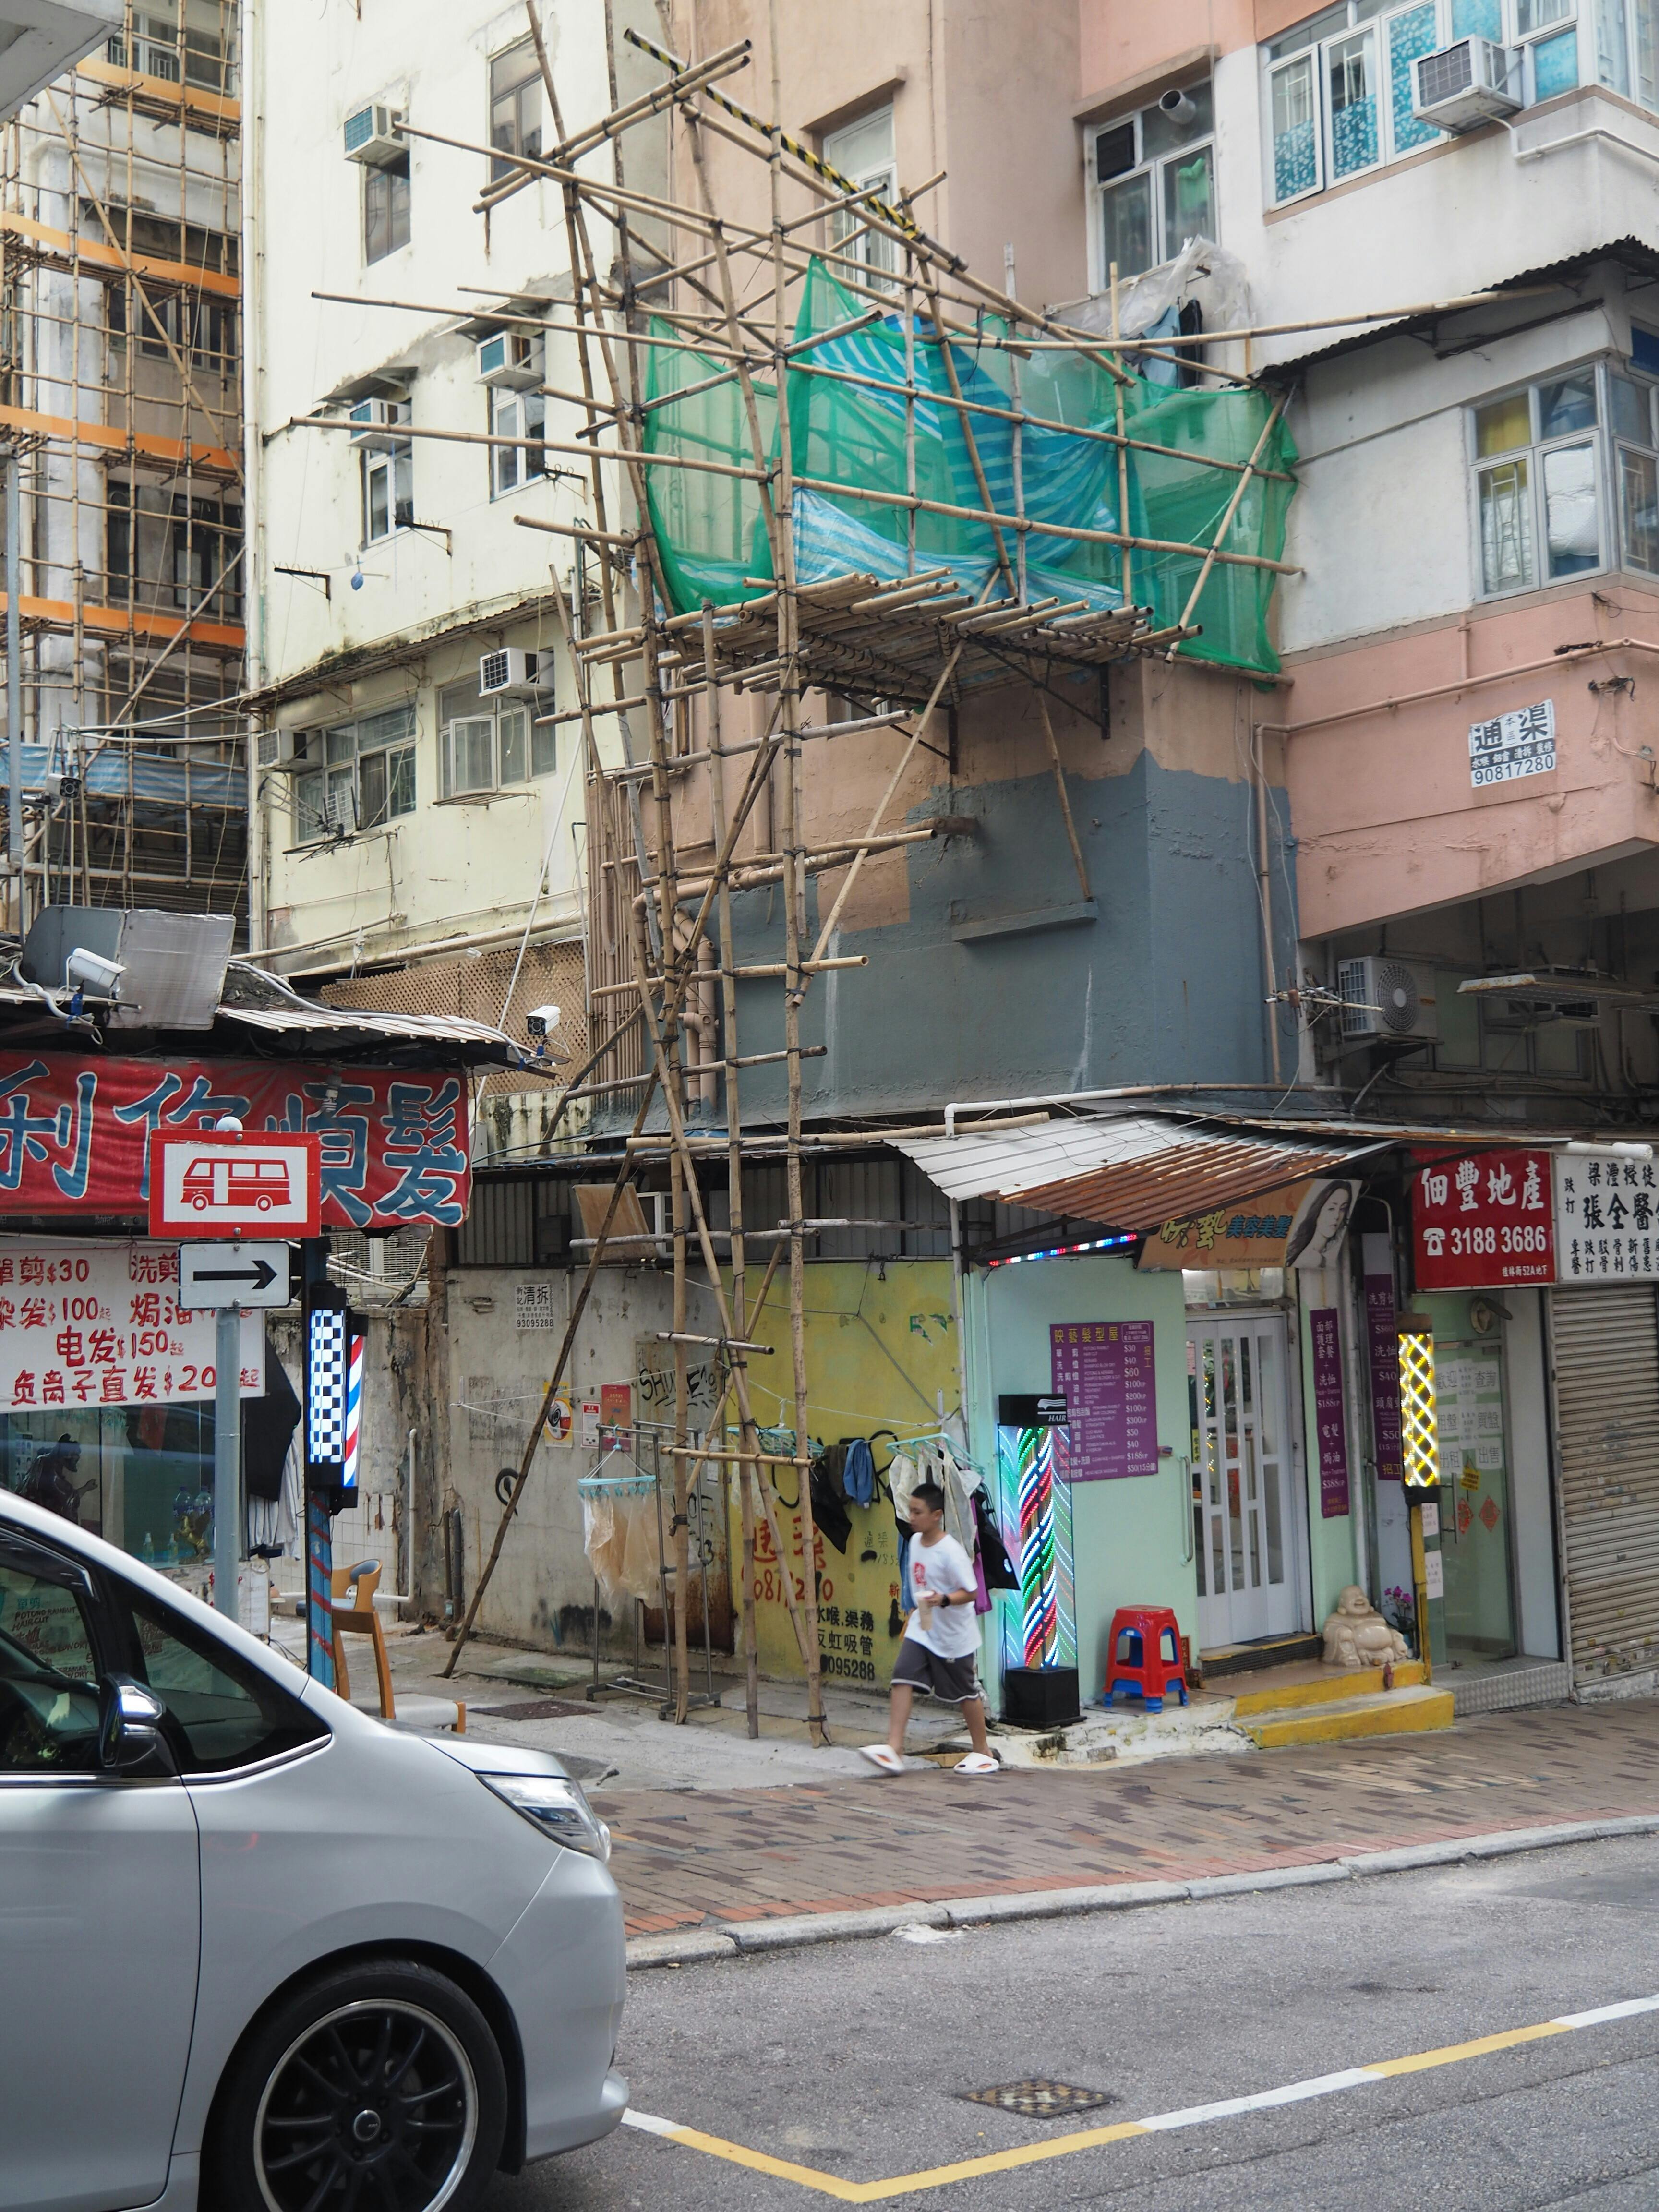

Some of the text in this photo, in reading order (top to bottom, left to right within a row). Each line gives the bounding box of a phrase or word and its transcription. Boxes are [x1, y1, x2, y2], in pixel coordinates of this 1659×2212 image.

[1475, 755, 1553, 784] 90817280
[1583, 1192, 1659, 1230] 張全醫
[1451, 1225, 1546, 1255] 3188 3686
[524, 1285, 548, 1305] 清拆
[517, 1318, 553, 1327] 93095288
[1054, 1326, 1118, 1343] 映藝髮型屋
[1124, 1357, 1136, 1365] $40
[1124, 1368, 1139, 1378] $60
[1379, 1371, 1396, 1381] $40
[11, 1365, 261, 1406] 负离子直发$20起
[1127, 1440, 1139, 1448] $40
[820, 1654, 875, 1681] 095288
